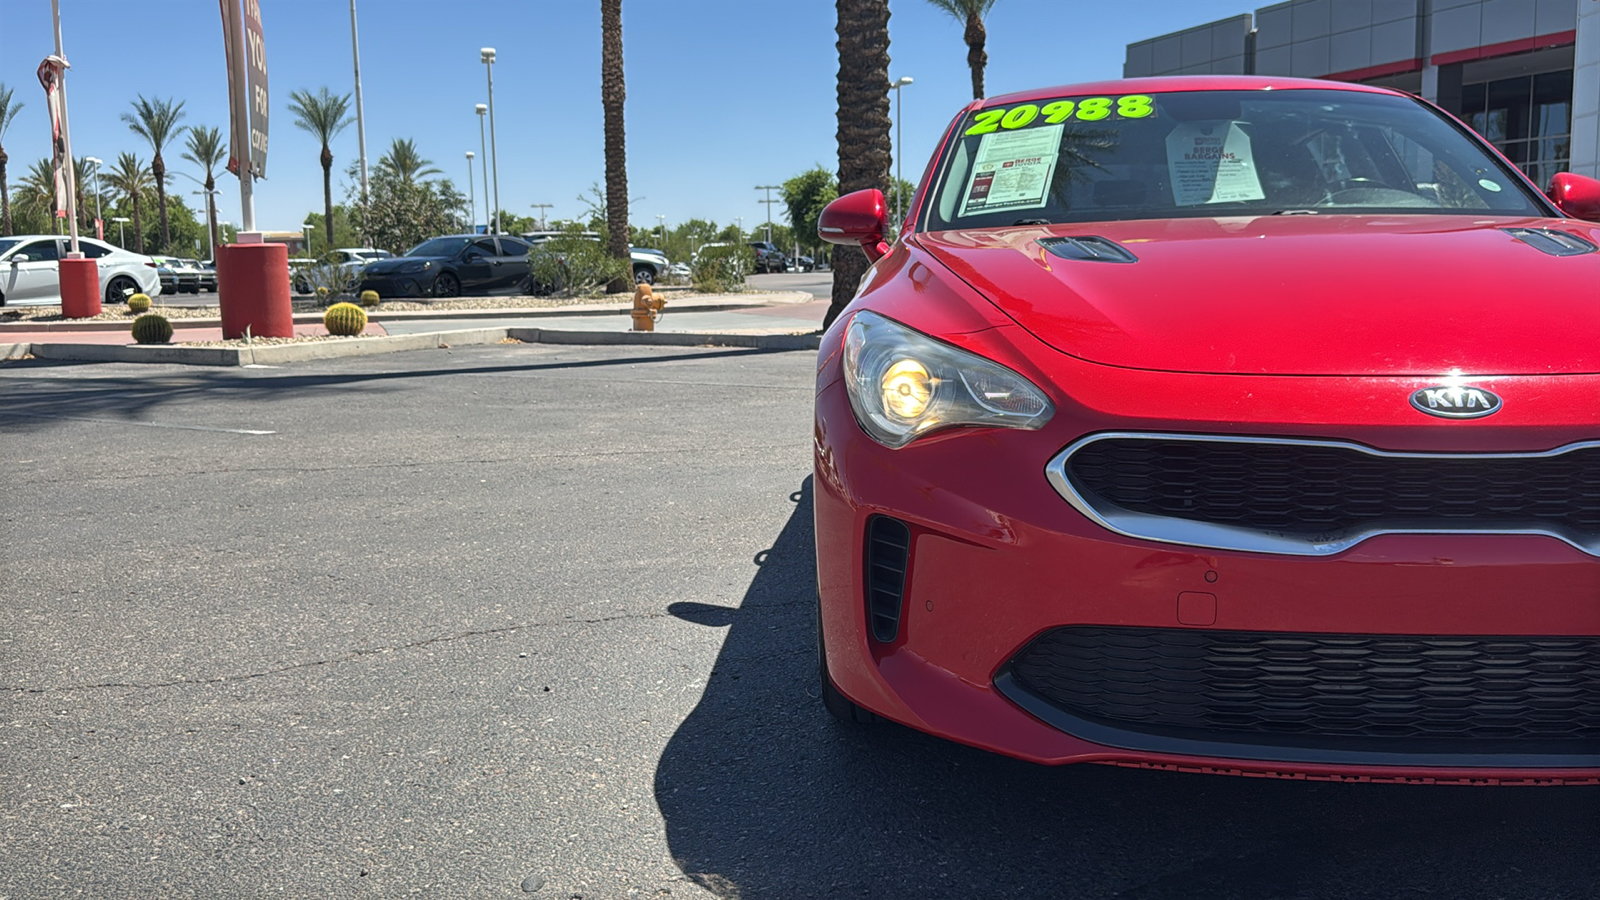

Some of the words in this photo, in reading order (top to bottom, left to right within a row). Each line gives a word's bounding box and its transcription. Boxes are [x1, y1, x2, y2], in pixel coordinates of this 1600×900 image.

[255, 84, 268, 119] FOR
[965, 95, 1154, 136] 20988
[1184, 152, 1236, 160] BARGAINS
[1193, 146, 1225, 154] BERGE
[1424, 388, 1490, 408] KIA
